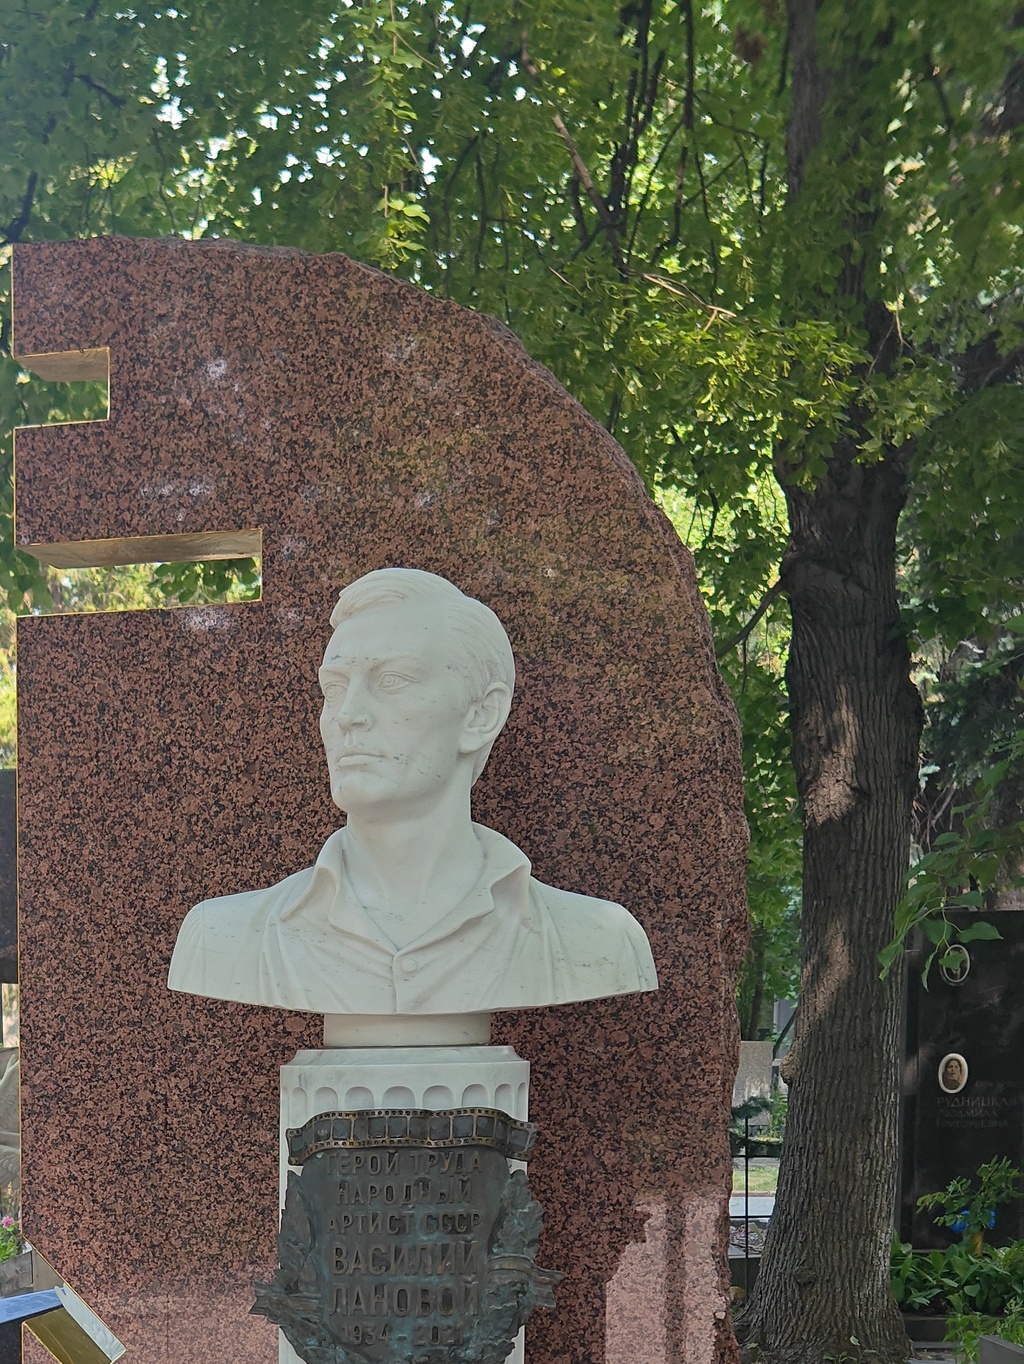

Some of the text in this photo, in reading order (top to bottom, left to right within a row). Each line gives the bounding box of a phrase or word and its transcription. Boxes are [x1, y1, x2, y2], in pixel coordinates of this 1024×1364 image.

[327, 1150, 484, 1176] ГЕРОЙ ТРУДА
[336, 1177, 472, 1206] НАРОДНЫЙ
[328, 1210, 484, 1235] АРТИСТ СССР
[331, 1240, 479, 1276] ВАСИЛИЙ
[329, 1280, 479, 1317] ЛАНОВОЙ
[342, 1322, 392, 1346] 1934
[413, 1322, 466, 1346] 2021
